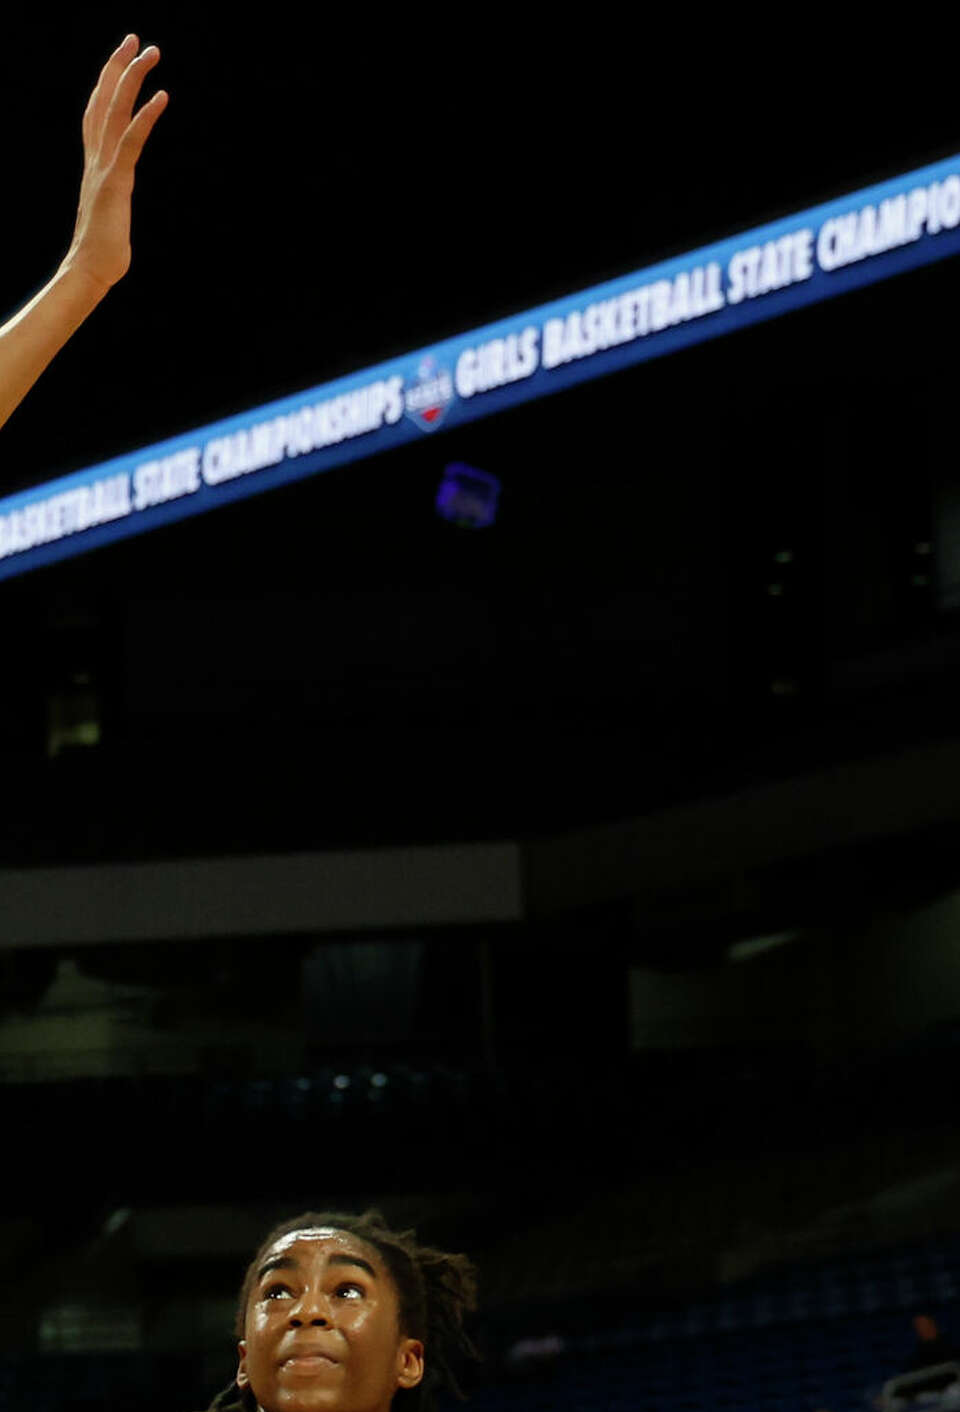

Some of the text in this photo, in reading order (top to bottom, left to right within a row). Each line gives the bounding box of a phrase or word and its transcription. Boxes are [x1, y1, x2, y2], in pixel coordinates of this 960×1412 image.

[455, 325, 539, 398] GIRLS
[541, 261, 725, 370] BASKETBALL
[727, 227, 813, 304] STATE
[133, 447, 202, 510] STATE
[202, 375, 404, 486] CHAMPIONSHIPS
